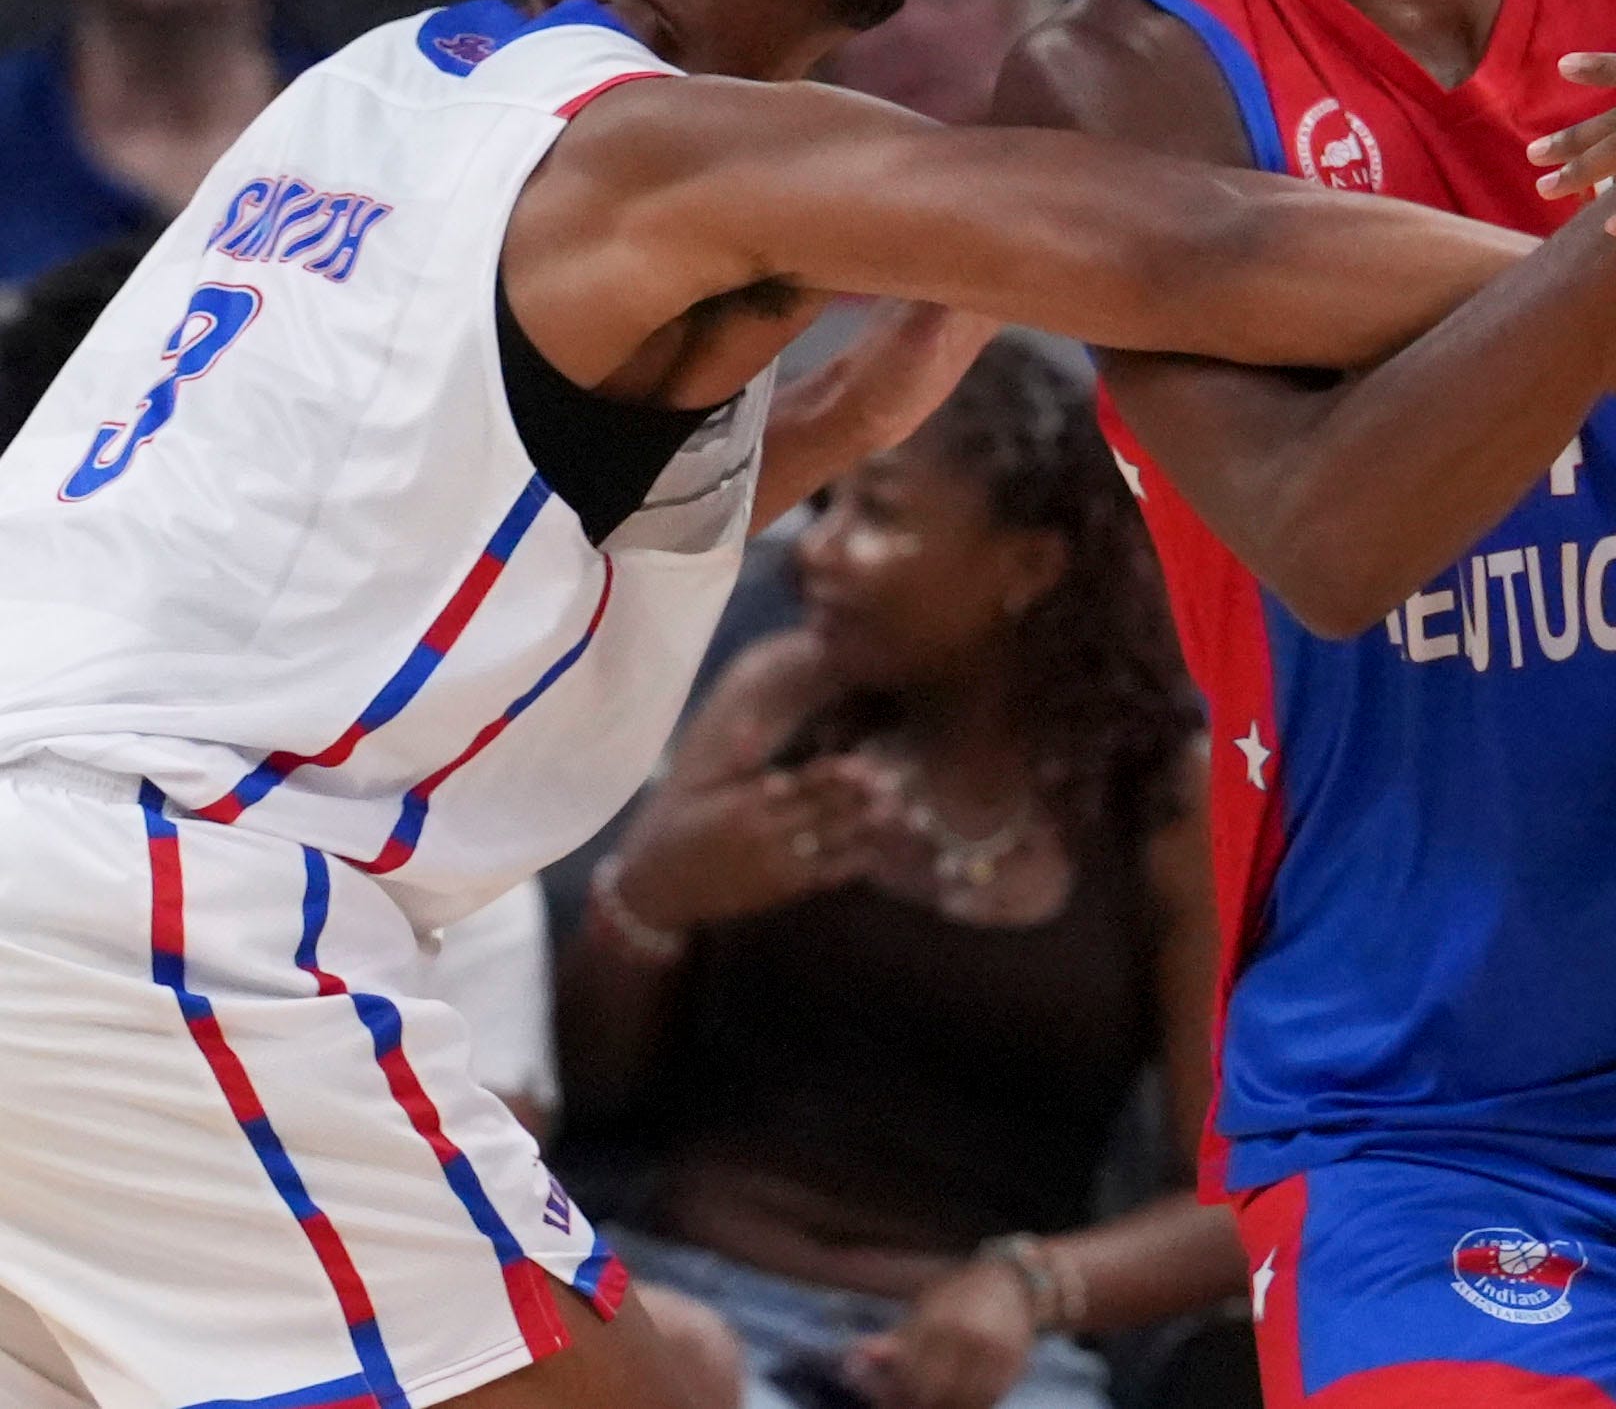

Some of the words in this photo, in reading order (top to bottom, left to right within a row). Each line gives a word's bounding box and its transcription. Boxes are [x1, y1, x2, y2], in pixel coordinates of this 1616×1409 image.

[203, 174, 394, 283] SMITH
[57, 281, 263, 502] 3
[1474, 1275, 1551, 1306] Indiana
